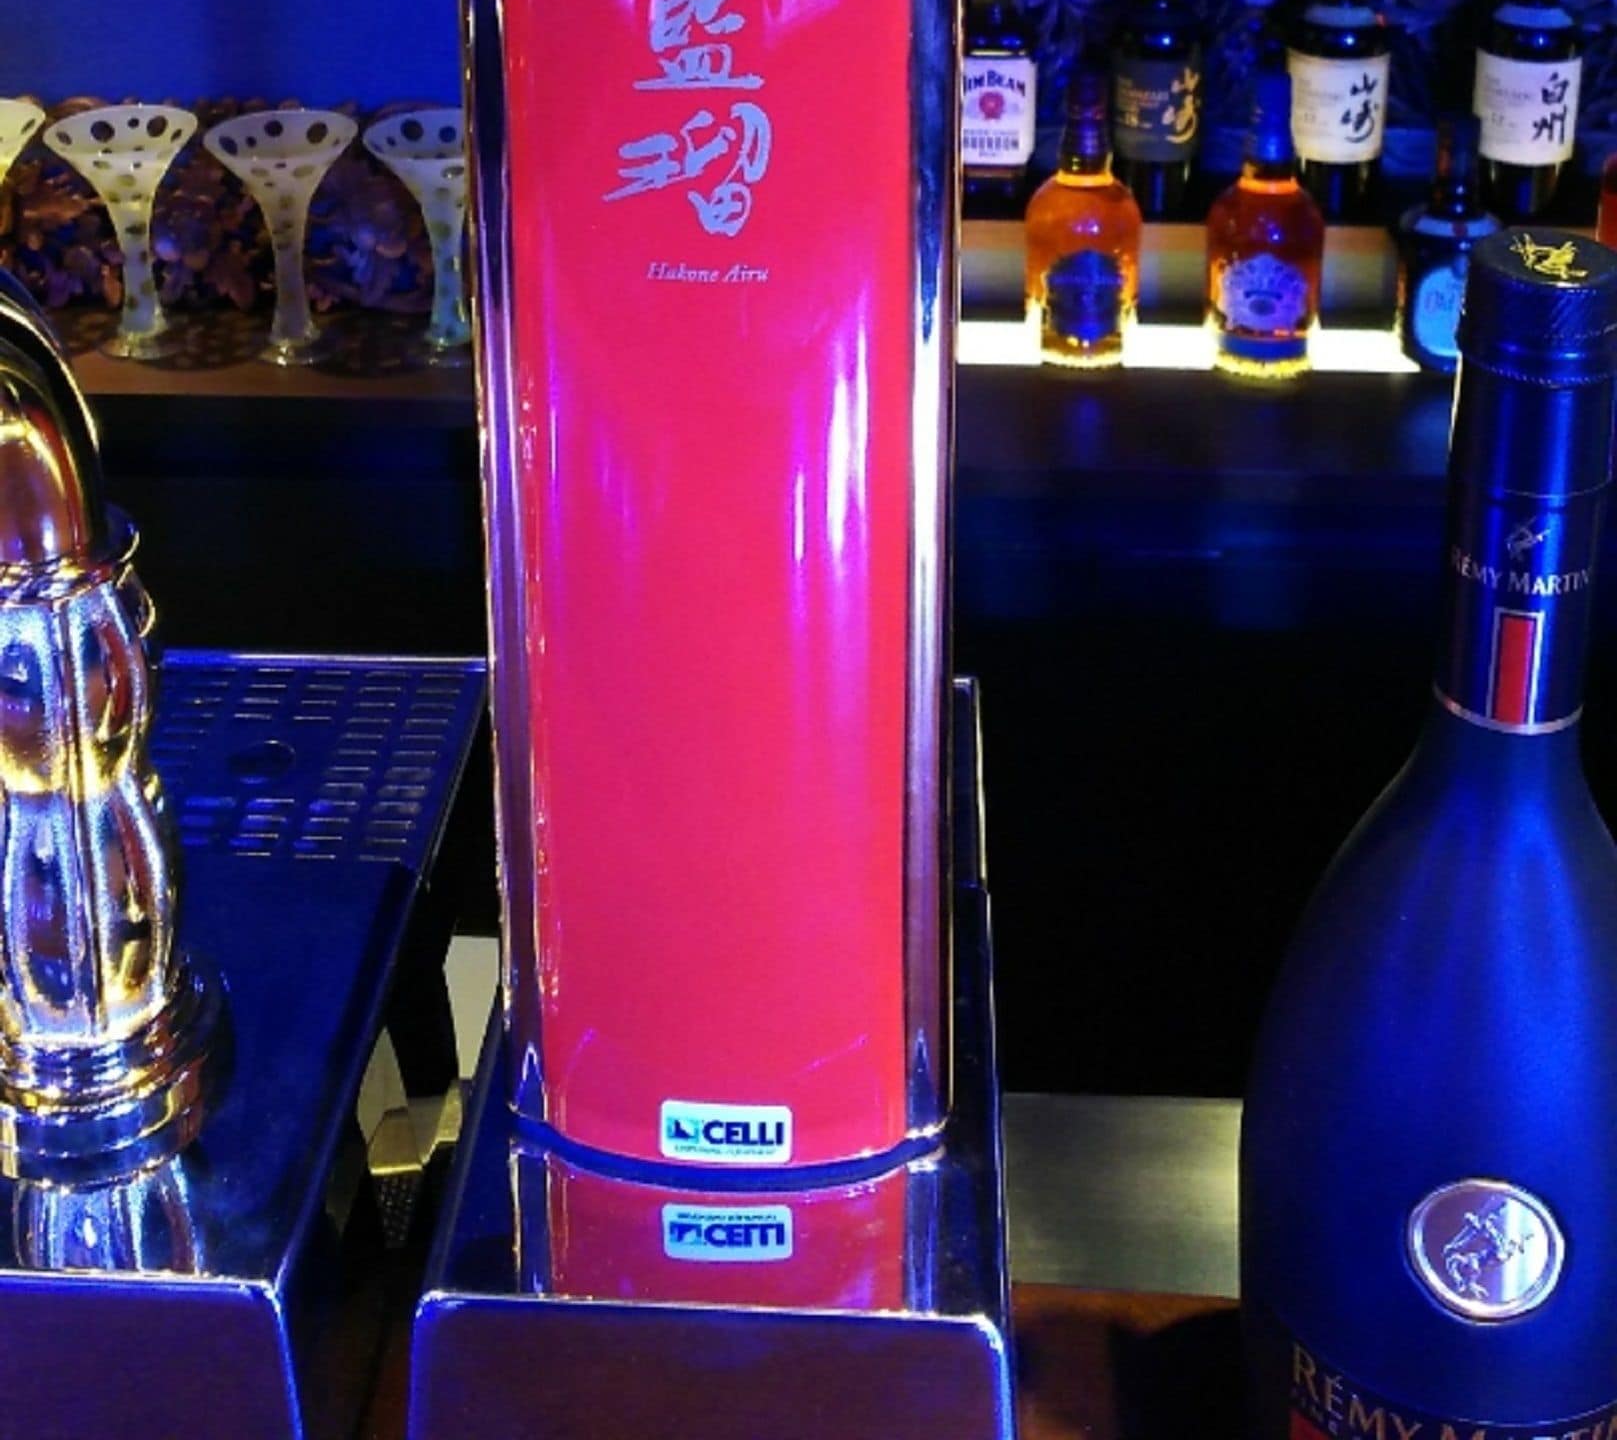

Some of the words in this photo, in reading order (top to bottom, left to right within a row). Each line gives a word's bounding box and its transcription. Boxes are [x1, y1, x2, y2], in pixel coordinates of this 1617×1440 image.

[1532, 72, 1570, 145] 白州
[647, 261, 720, 282] Hakone
[1507, 565, 1595, 596] MARTIN
[702, 1119, 785, 1146] CELLI
